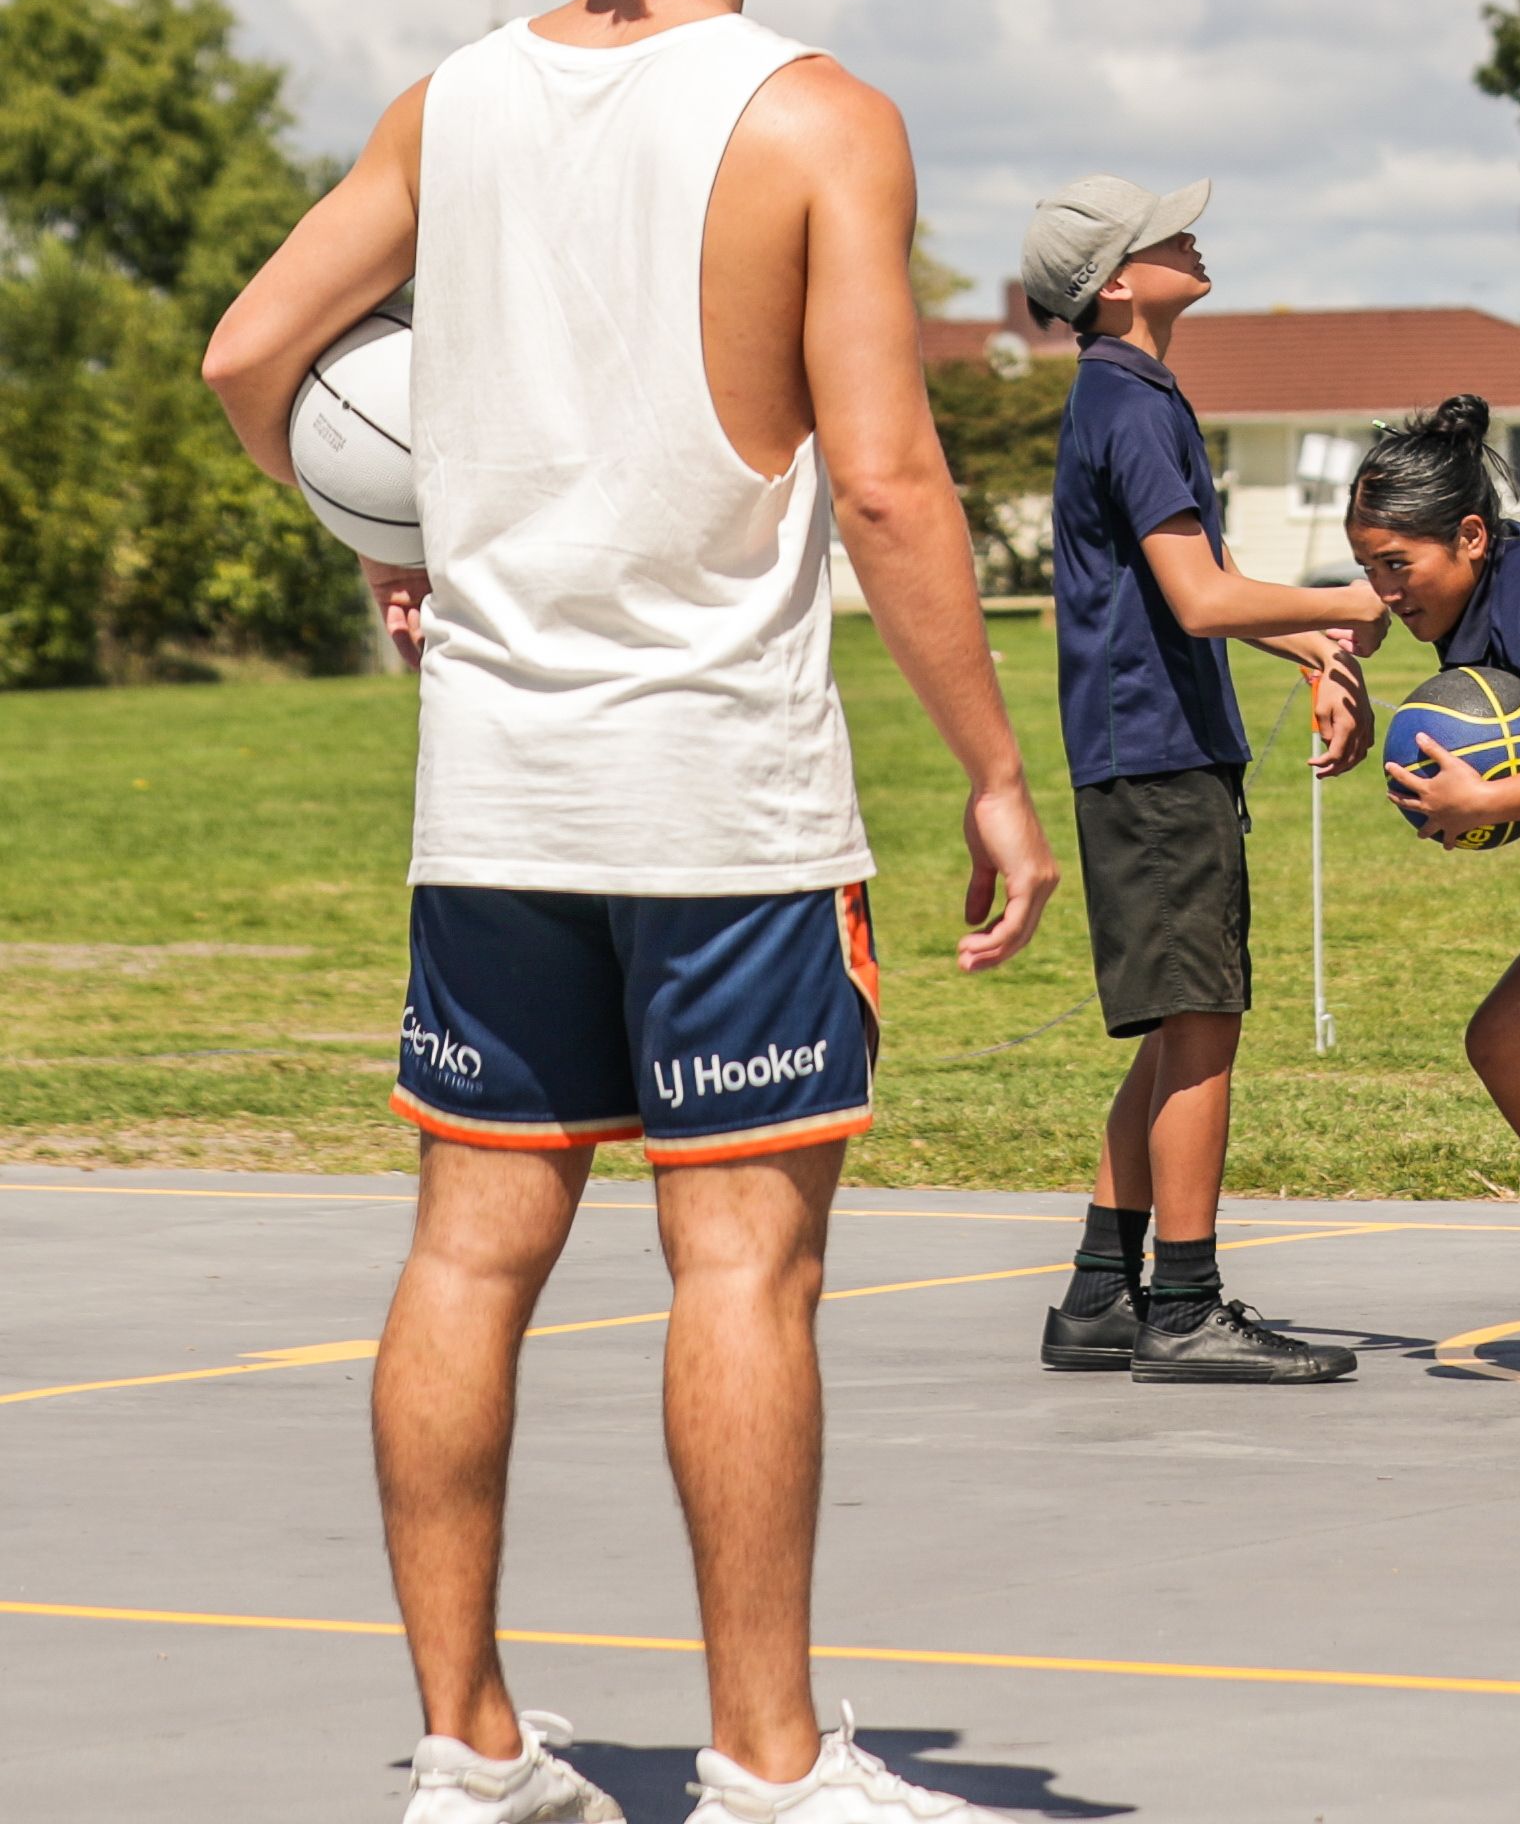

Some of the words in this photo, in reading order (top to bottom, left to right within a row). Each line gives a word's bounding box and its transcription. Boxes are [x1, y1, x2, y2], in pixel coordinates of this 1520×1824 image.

[1065, 261, 1098, 297] WCC
[653, 1058, 684, 1109] LJ
[693, 1039, 827, 1097] Hooker
